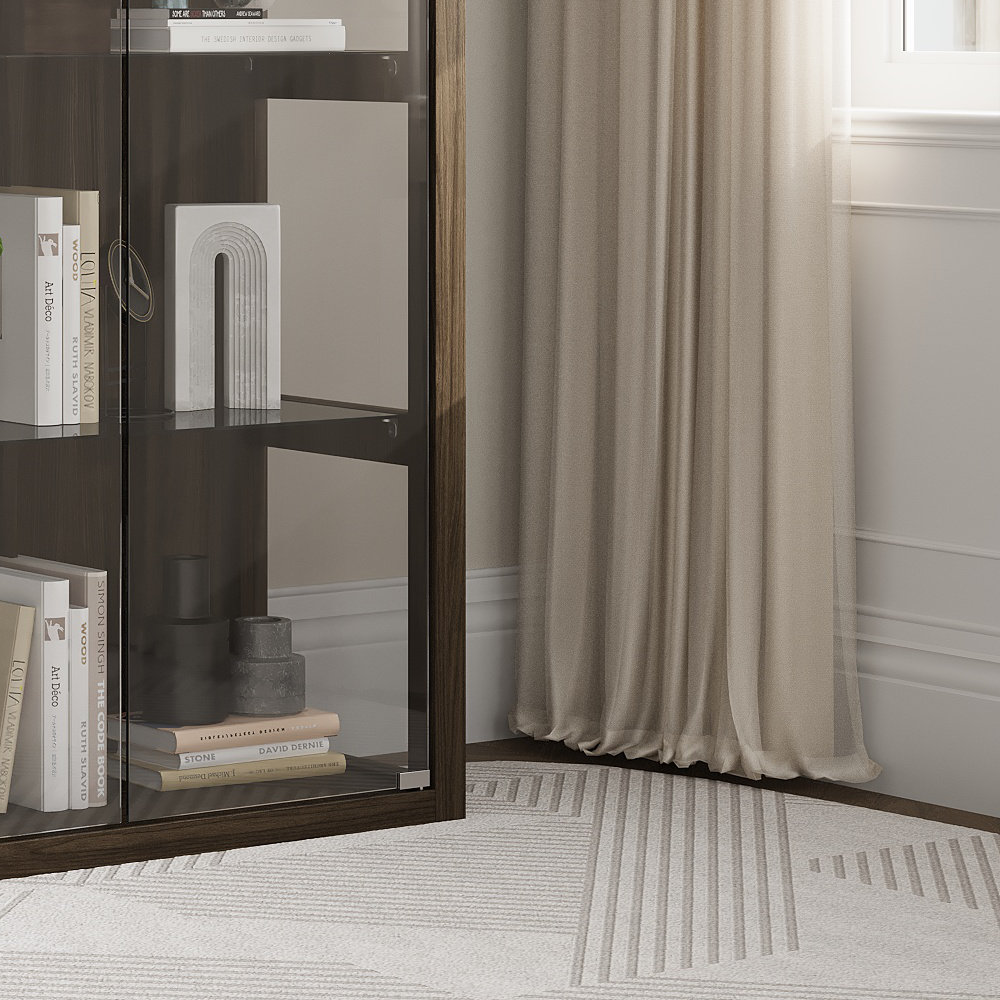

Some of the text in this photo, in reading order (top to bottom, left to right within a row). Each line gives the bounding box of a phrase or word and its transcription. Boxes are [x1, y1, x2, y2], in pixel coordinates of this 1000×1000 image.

[45, 281, 54, 295] Art
[45, 298, 55, 322] Déco
[83, 309, 94, 357] VLADIMIR
[83, 362, 95, 409] NABOKOV
[97, 580, 105, 674] SIMON SINGH
[51, 666, 60, 681] Art
[51, 684, 61, 708] Déco
[97, 680, 105, 798] THE CODE BOOK
[259, 740, 324, 755] DAVID DERNIE
[185, 753, 216, 764] STONE
[178, 773, 206, 782] Desmond
[207, 770, 230, 779] Michael
